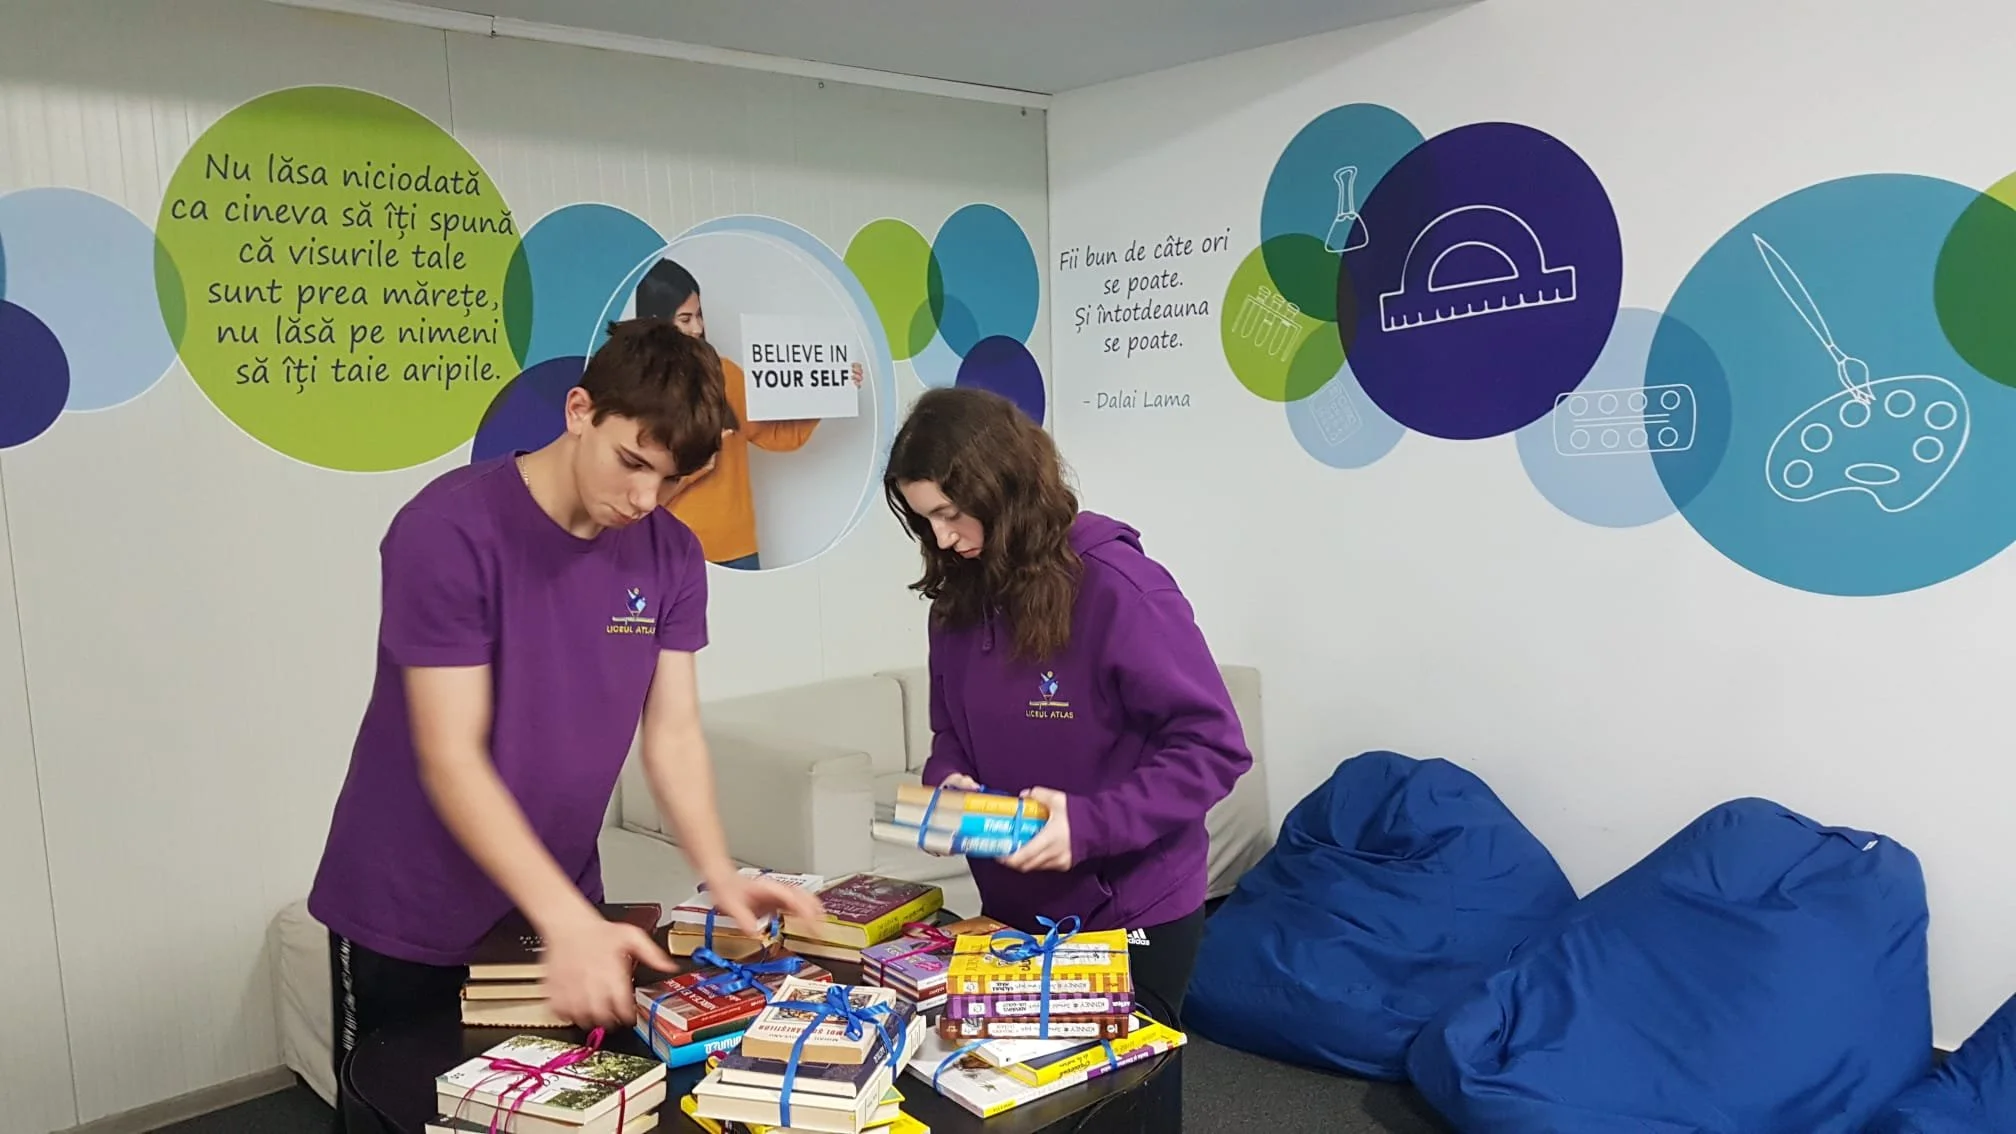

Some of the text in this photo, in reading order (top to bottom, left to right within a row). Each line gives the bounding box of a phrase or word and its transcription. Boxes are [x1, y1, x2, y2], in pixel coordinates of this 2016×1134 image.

[205, 153, 481, 196] Nu lăsa niciodată
[171, 193, 514, 240] ca cineva să îți spună
[239, 236, 467, 270] că visurile tale
[1059, 227, 1231, 271] Fii bun de câte ori
[208, 279, 282, 305] sunt
[297, 283, 368, 314] prea
[1104, 269, 1184, 300] se poate.
[1097, 298, 1209, 325] întotdeauna
[217, 315, 498, 353] nu lăsă pe nimeni
[1104, 330, 1184, 359] se poate.
[752, 344, 847, 363] BELIEVE IN
[236, 355, 501, 394] să îți taie aripile.
[752, 370, 849, 388] YOUR SELF
[1097, 389, 1138, 409] Dalai
[1143, 390, 1191, 408] Lama
[606, 625, 633, 634] LICEUL
[1025, 709, 1074, 719] LICEUL ATLAS
[1128, 937, 1150, 946] didas
[1080, 1001, 1105, 1009] KINNEY
